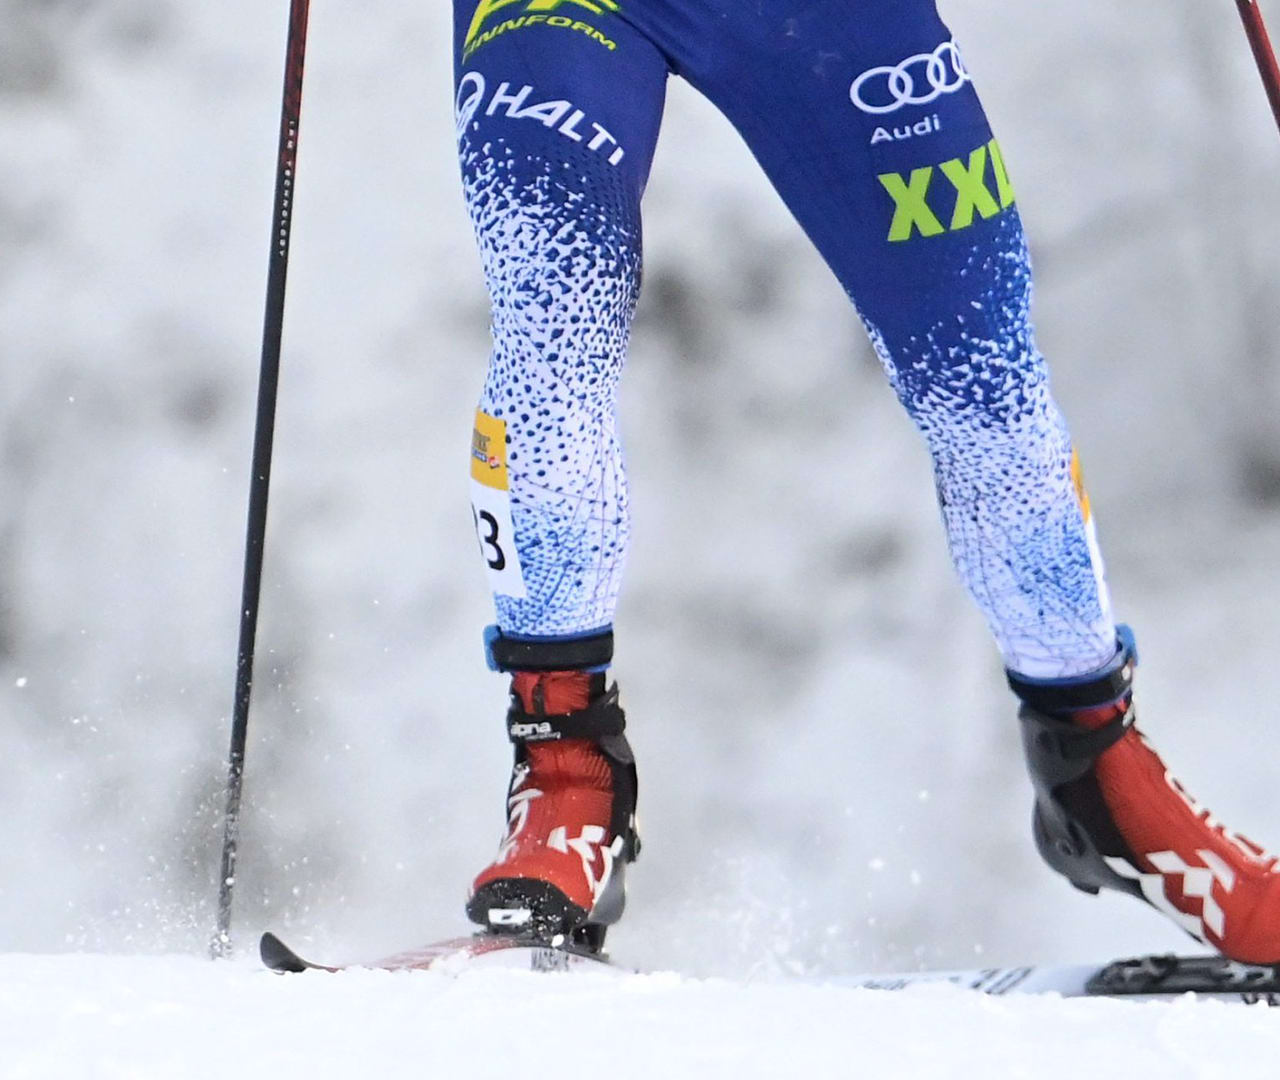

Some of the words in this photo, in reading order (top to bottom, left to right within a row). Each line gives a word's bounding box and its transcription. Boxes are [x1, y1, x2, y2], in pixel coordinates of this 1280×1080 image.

[486, 81, 625, 166] HALTI
[870, 113, 941, 145] Audi
[472, 502, 506, 571] 3
